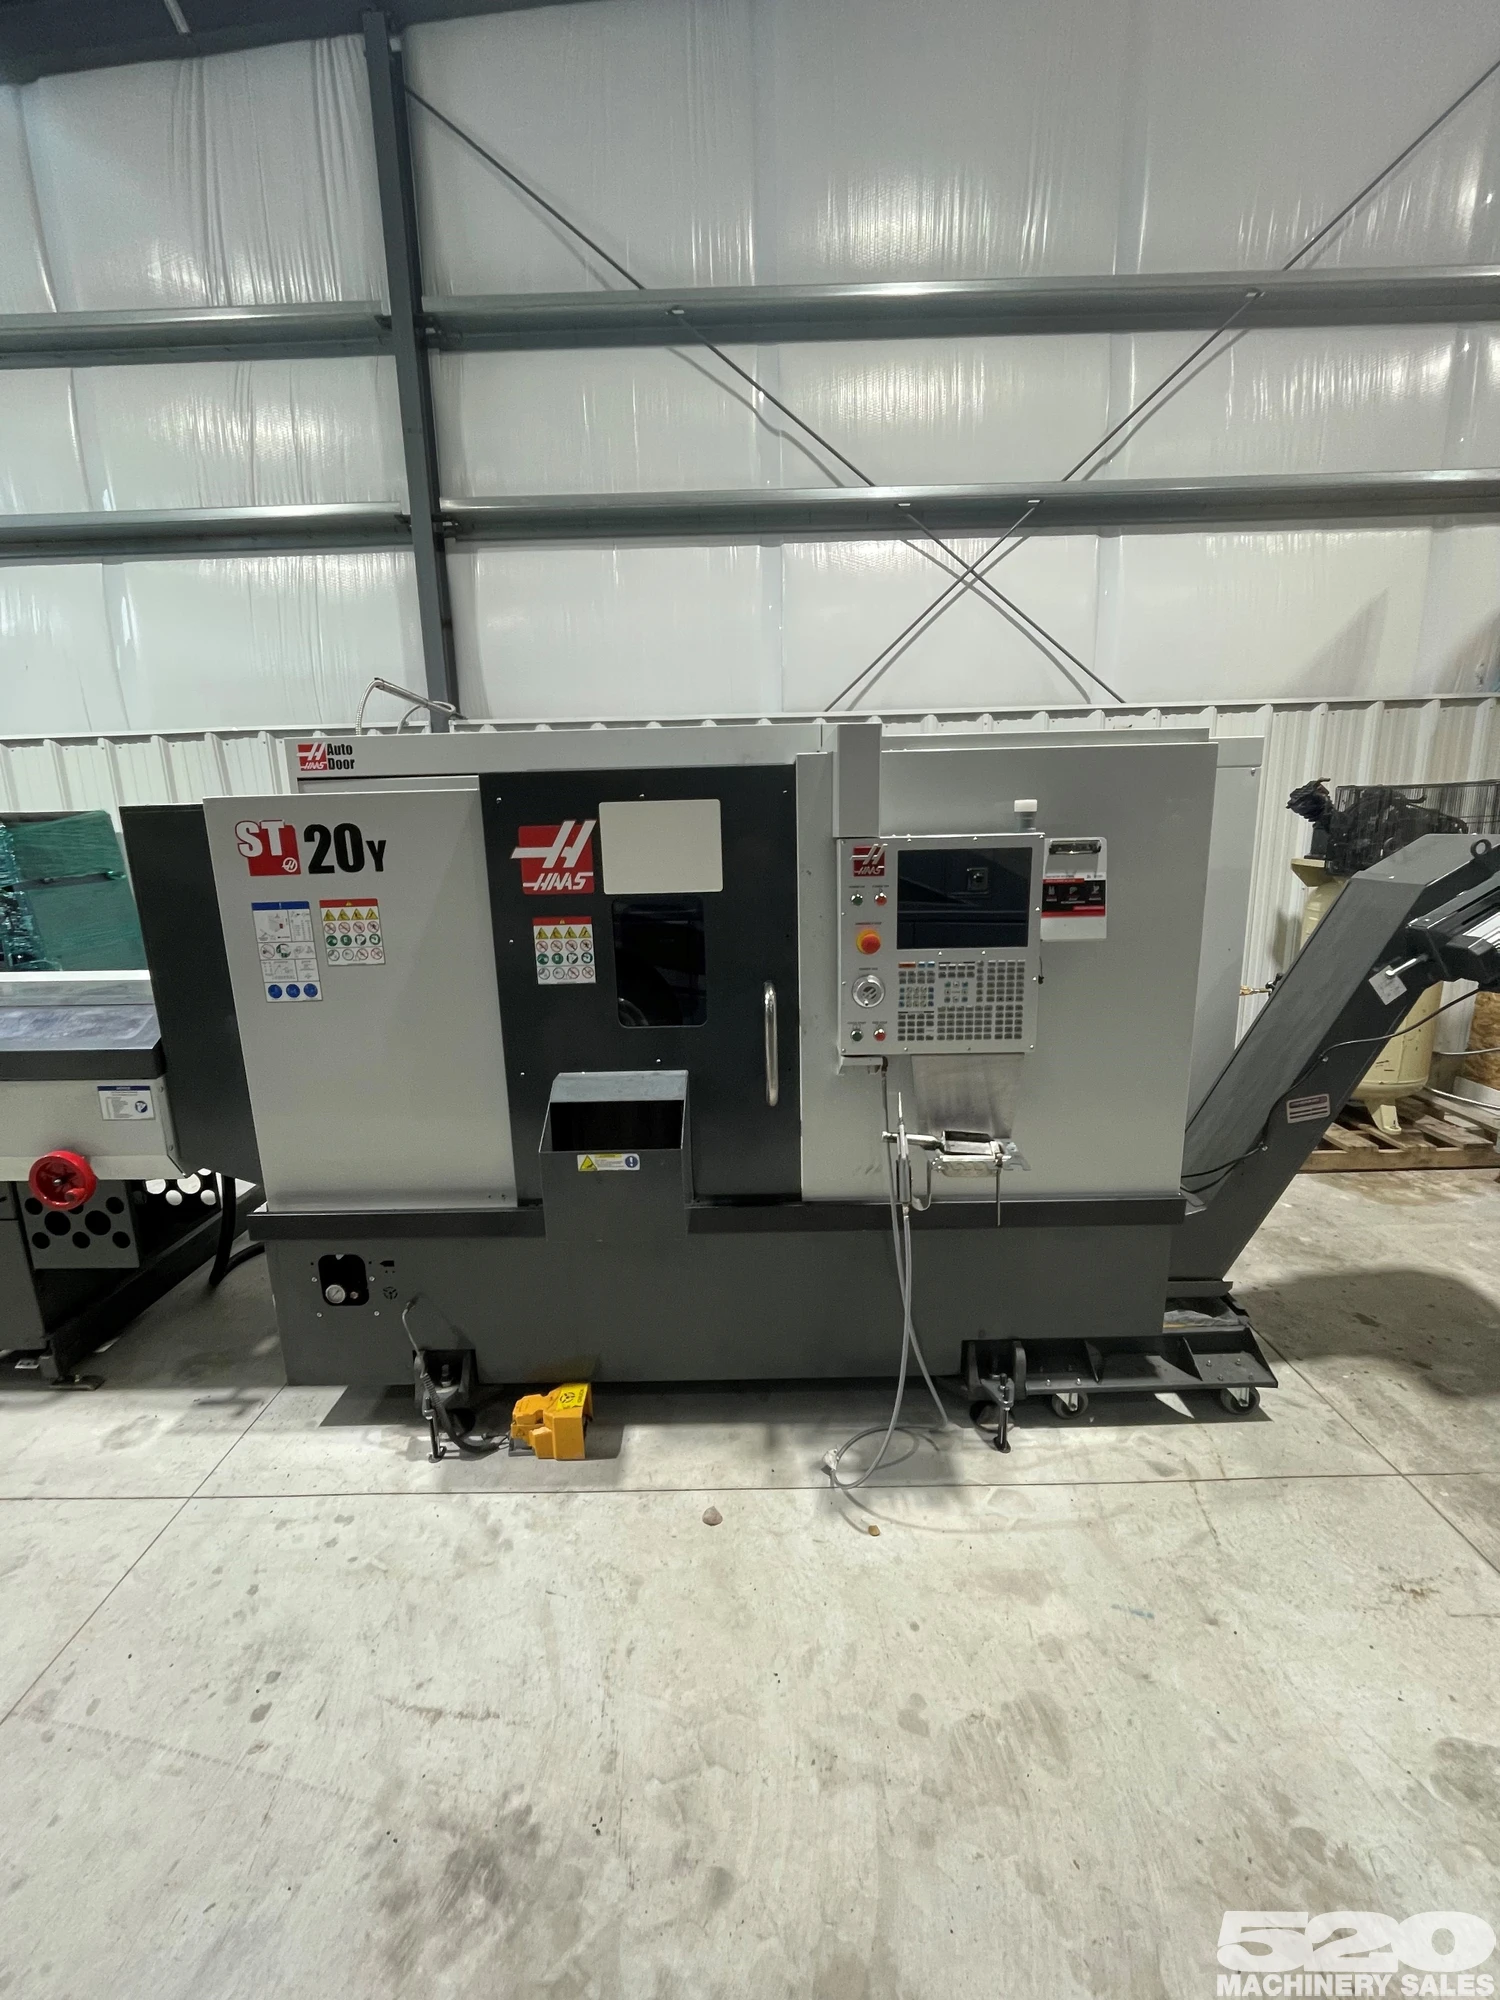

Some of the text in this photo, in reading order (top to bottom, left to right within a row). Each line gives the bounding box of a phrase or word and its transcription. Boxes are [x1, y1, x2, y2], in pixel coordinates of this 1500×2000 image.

[327, 743, 353, 756] Auto
[301, 761, 327, 770] HAAS
[328, 757, 355, 770] Door
[235, 819, 286, 858] ST
[854, 865, 885, 875] HAAS
[523, 871, 594, 891] HAAS
